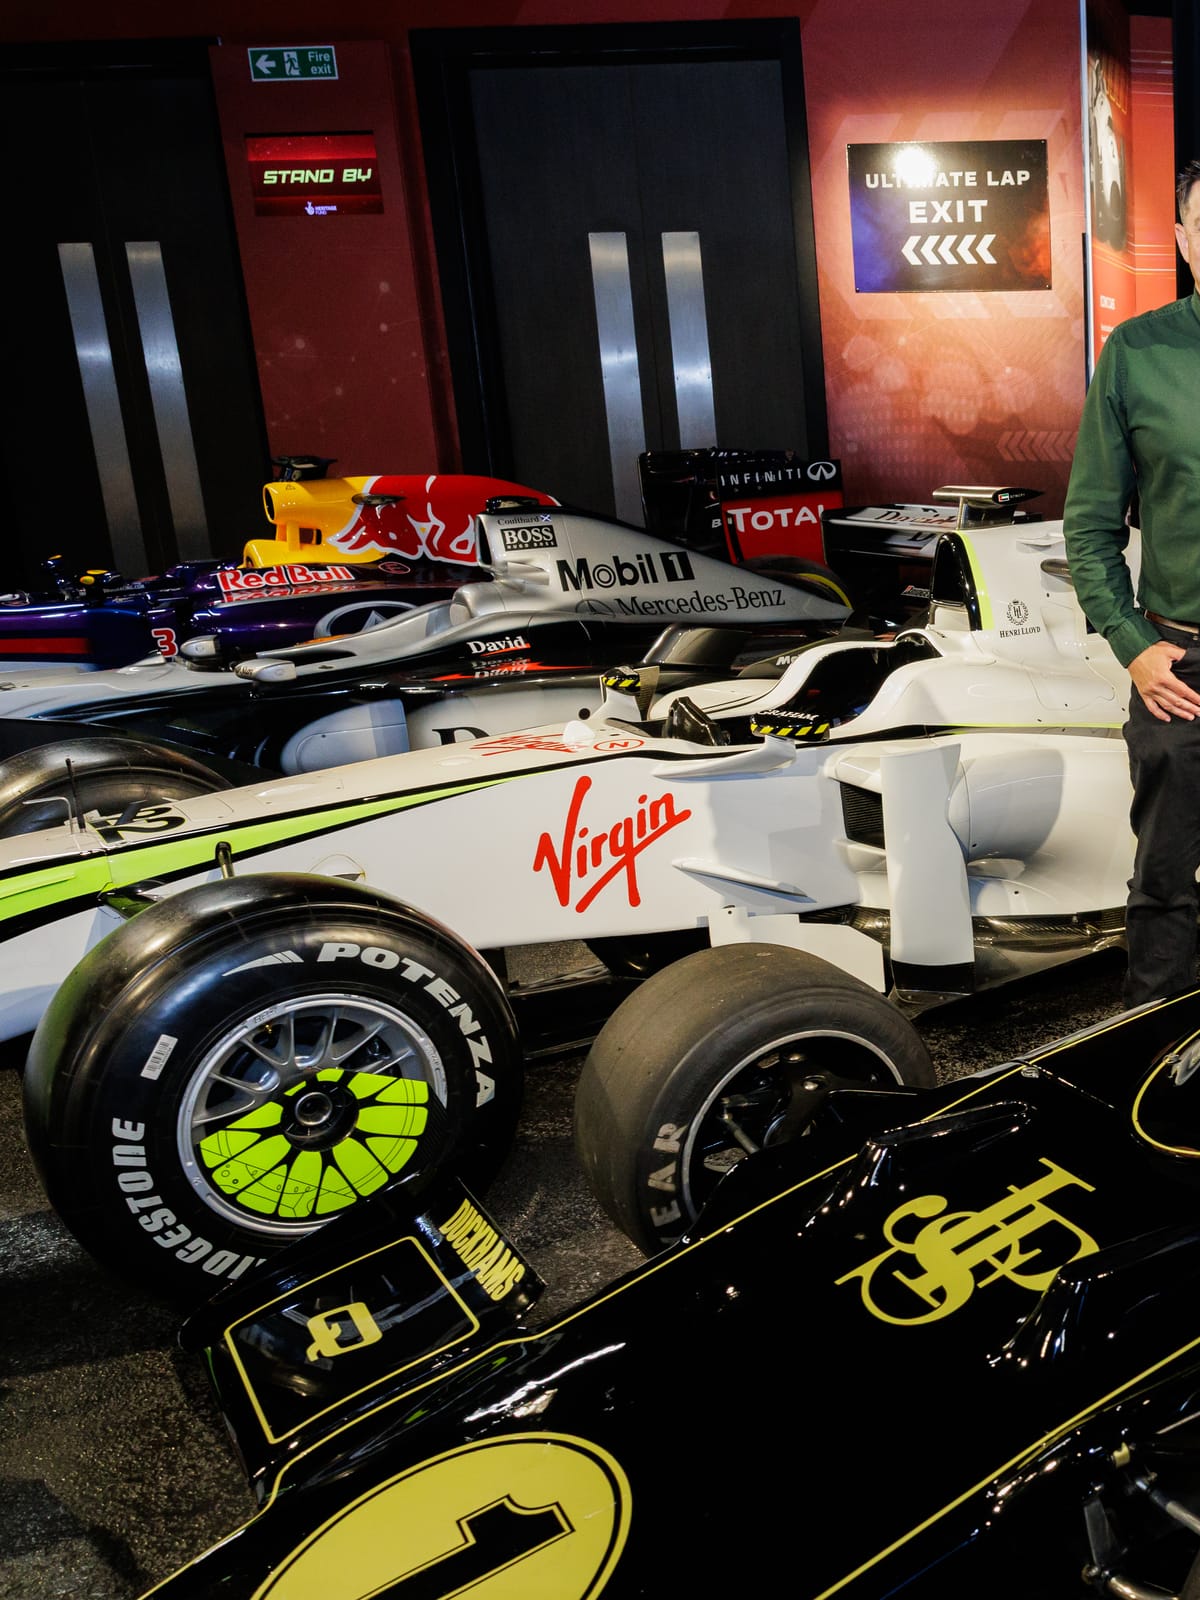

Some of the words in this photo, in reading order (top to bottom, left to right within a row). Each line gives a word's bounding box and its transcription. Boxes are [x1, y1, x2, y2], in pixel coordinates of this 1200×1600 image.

[307, 51, 331, 62] Fire
[310, 64, 332, 75] exit
[263, 169, 335, 184] STAND
[342, 168, 372, 183] BY
[865, 171, 977, 189] ULTATE
[987, 170, 1031, 187] LAP
[909, 199, 988, 224] EXIT
[720, 467, 801, 487] INFINITI
[497, 515, 540, 526] Coulthard
[503, 526, 554, 545] BOSS
[216, 565, 287, 593] Red
[285, 564, 355, 587] Bull
[556, 553, 659, 592] Mobil
[614, 585, 786, 617] Mercedes-Benz
[151, 627, 178, 657] 3
[466, 635, 526, 654] David
[1000, 627, 1020, 638] HENRI
[1020, 625, 1041, 637] LLOYD
[532, 775, 692, 913] Virgin
[316, 942, 497, 1108] POTENZA
[647, 1122, 688, 1229] EAR
[111, 1117, 265, 1280] IDGESTONE
[439, 1197, 526, 1302] DUCKHAMS
[350, 1493, 577, 1600] 1
